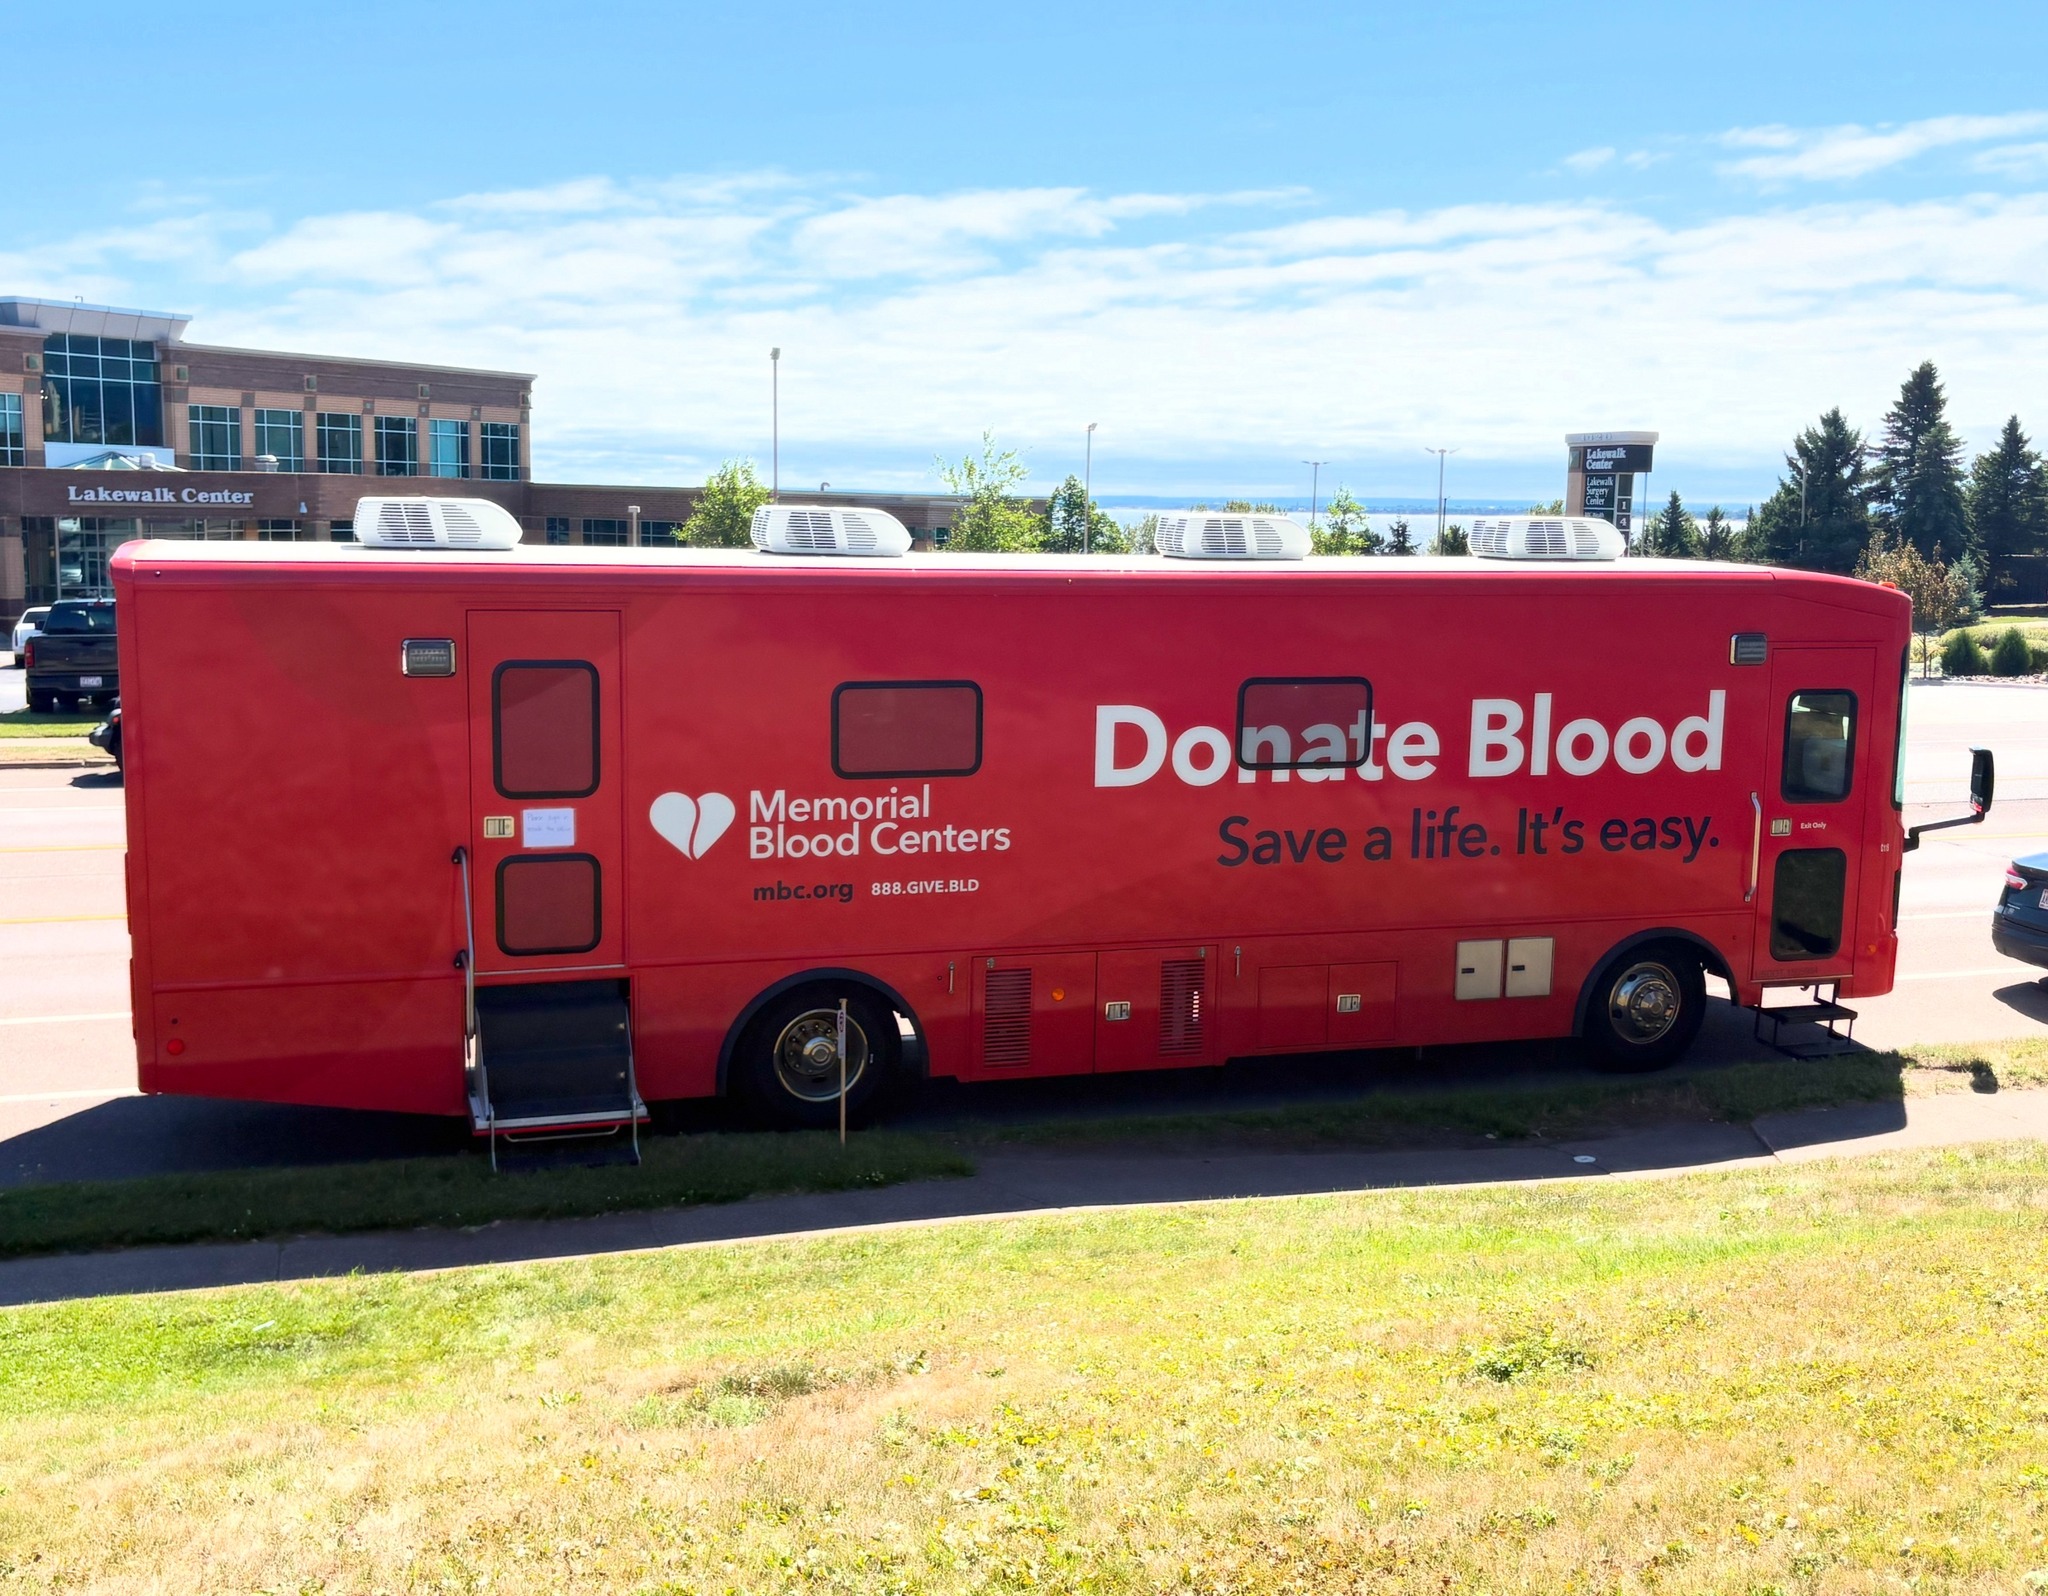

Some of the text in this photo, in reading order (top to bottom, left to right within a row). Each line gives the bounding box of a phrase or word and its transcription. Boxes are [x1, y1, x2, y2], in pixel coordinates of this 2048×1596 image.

[1586, 447, 1626, 459] Lakewalk
[1585, 459, 1614, 470] Center
[1586, 476, 1613, 486] Lakewalk
[67, 486, 254, 504] Lakewalk Center
[1586, 486, 1609, 498] Surgery
[1585, 495, 1605, 506] Center
[1621, 501, 1627, 510] 1
[1619, 518, 1627, 526] 4
[1094, 689, 1726, 788] Donate Blood
[750, 784, 930, 823] Memorial
[1812, 821, 1827, 830] Only
[750, 821, 1011, 860] Blood Centers
[1216, 806, 1719, 867] Save a life. It’s easy.
[753, 880, 854, 903] mbc.org
[871, 879, 980, 896] 888.GIVE.BLD
